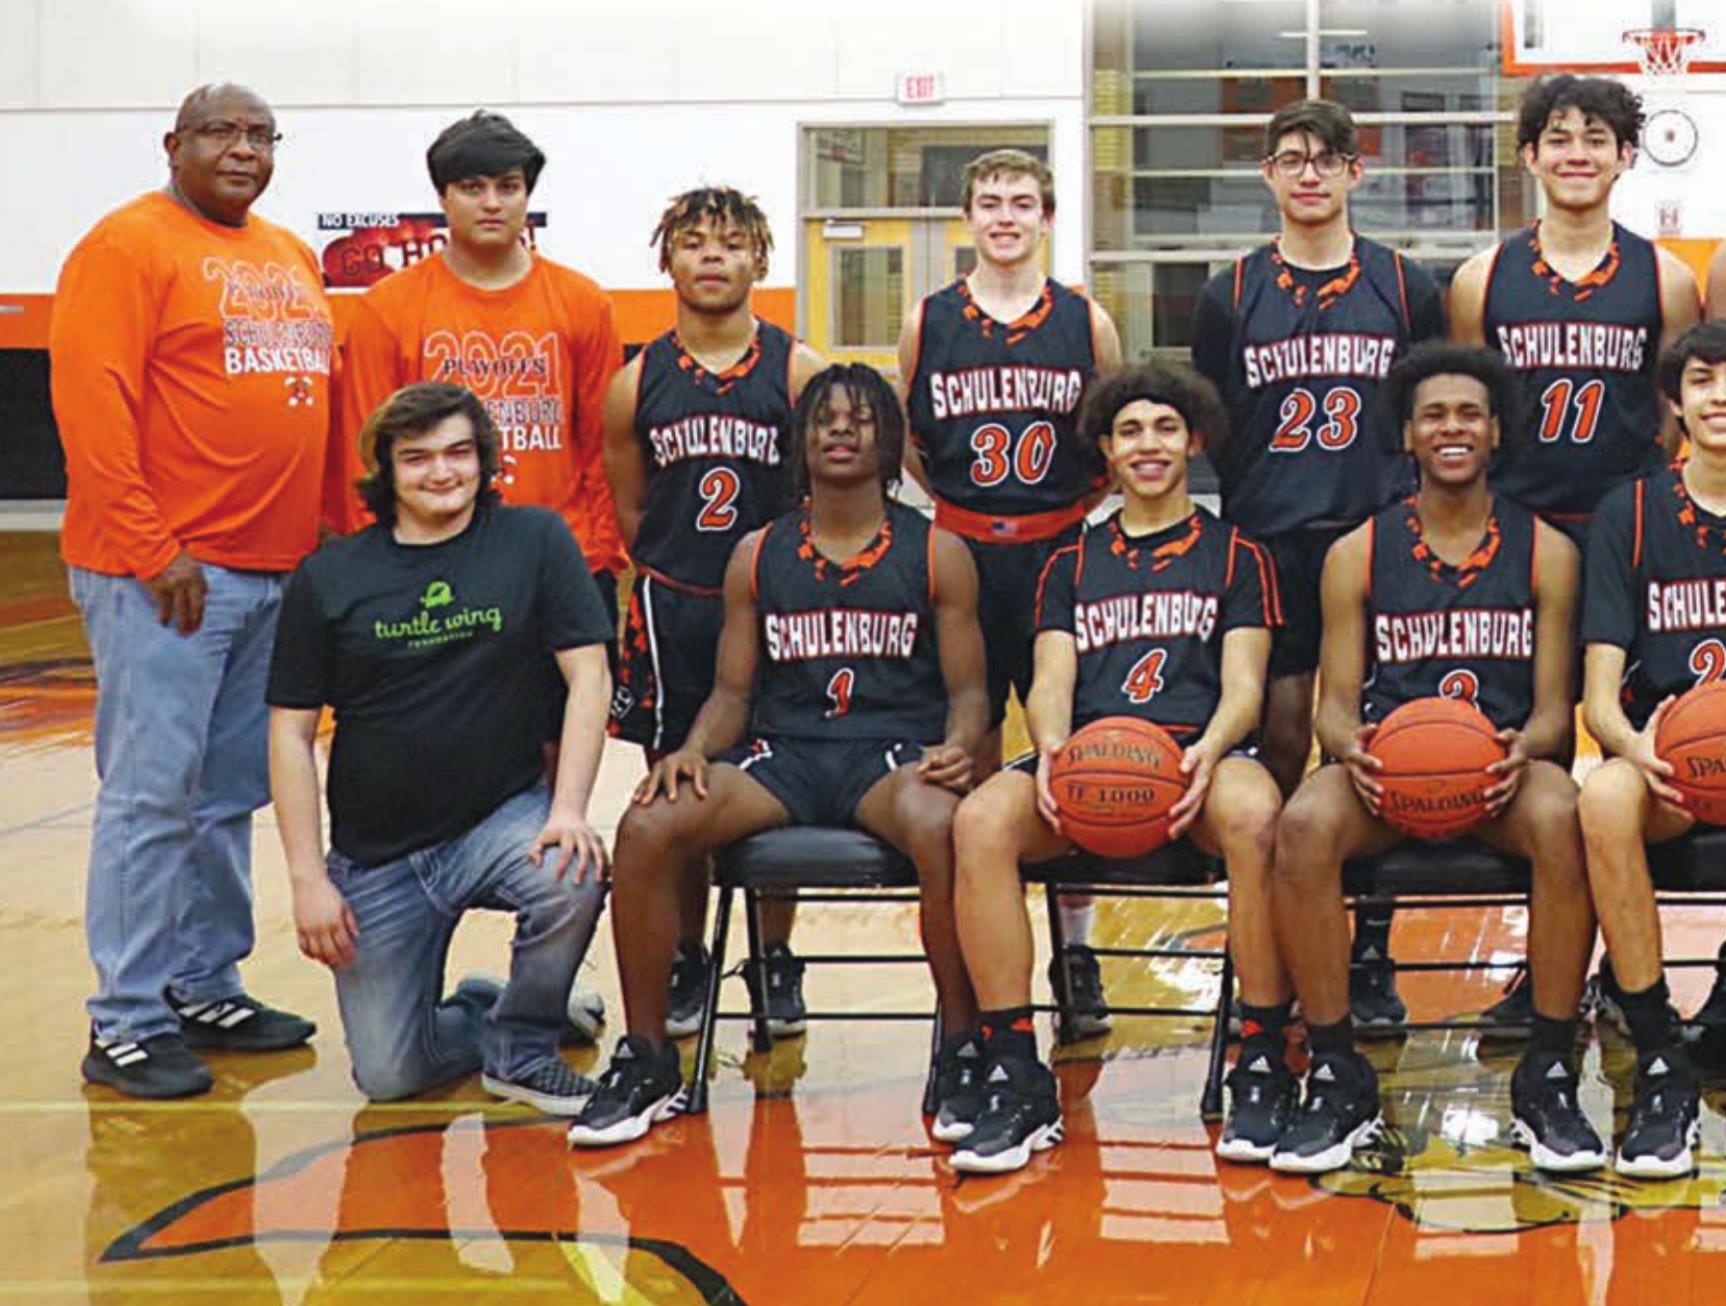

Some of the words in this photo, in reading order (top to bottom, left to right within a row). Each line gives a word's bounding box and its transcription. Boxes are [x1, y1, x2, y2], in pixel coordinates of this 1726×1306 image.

[906, 76, 934, 98] EXIT
[321, 213, 342, 227] NO
[348, 213, 397, 226] EXCUSES
[341, 244, 384, 276] GO
[424, 330, 562, 400] 2021
[1244, 333, 1395, 388] SCHULENBURG
[1497, 323, 1647, 371] SCHULENBURG
[930, 366, 1083, 420] SCHULENBURG
[1268, 387, 1361, 452] 23
[1539, 378, 1605, 442] 11
[970, 421, 1057, 487] 30
[696, 466, 740, 531] 2
[374, 610, 441, 639] turtle
[445, 606, 502, 632] wing
[765, 611, 919, 661] SCHULENBURG
[1375, 608, 1534, 662] SCHULENBURG
[824, 667, 855, 719] 1
[1121, 647, 1168, 704] 4
[1068, 741, 1161, 769] SPALDING
[1098, 786, 1156, 805] 1000
